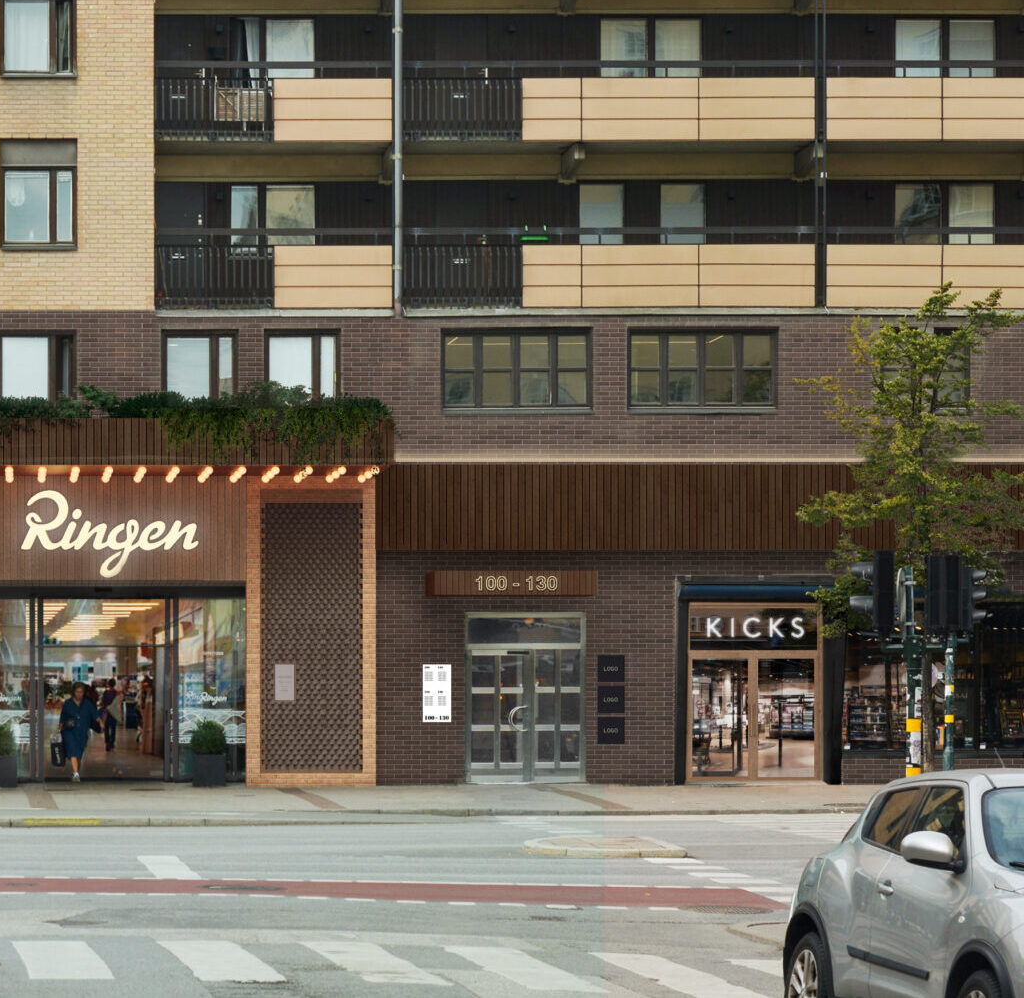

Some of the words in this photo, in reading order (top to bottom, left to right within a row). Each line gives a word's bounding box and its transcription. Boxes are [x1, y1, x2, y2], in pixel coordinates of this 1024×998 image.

[21, 490, 199, 578] Ringen
[476, 576, 508, 591] 100
[526, 576, 558, 591] 130
[706, 617, 805, 639] KICKS
